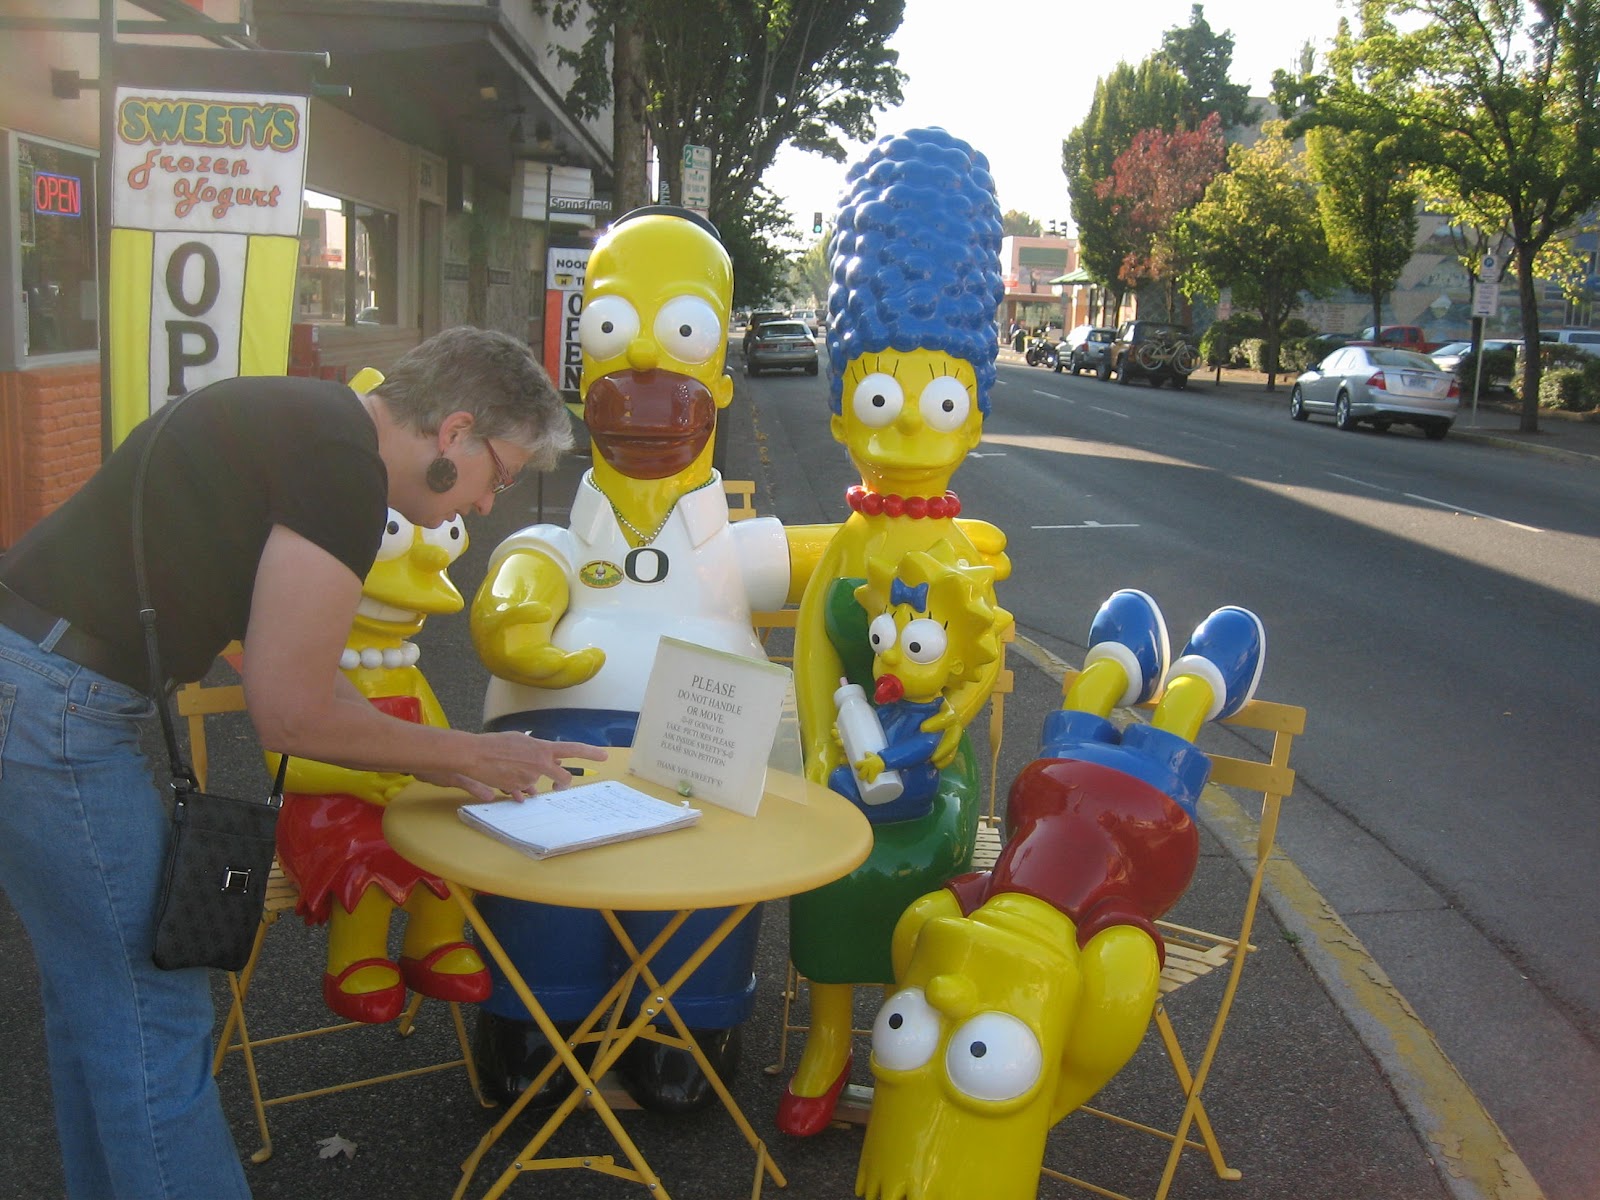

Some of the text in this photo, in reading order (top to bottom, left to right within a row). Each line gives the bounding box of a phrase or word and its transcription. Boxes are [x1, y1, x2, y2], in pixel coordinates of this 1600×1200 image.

[36, 176, 80, 213] OPEN
[173, 177, 281, 219] Yogurt
[551, 196, 611, 211] Springfield
[625, 548, 669, 584] O
[691, 674, 737, 698] PLEASE
[677, 689, 743, 715] DO NOT HANDLE
[686, 705, 698, 716] OR
[663, 731, 675, 741] ASK
[676, 735, 695, 748] INSIDE
[666, 721, 735, 749] TAKE PICTURES PLEASE
[694, 720, 714, 733] GOING
[715, 726, 724, 735] TO
[660, 740, 726, 767] PLEASE SIGN PETITION
[656, 759, 676, 772] THANK
[677, 766, 690, 777] YOU
